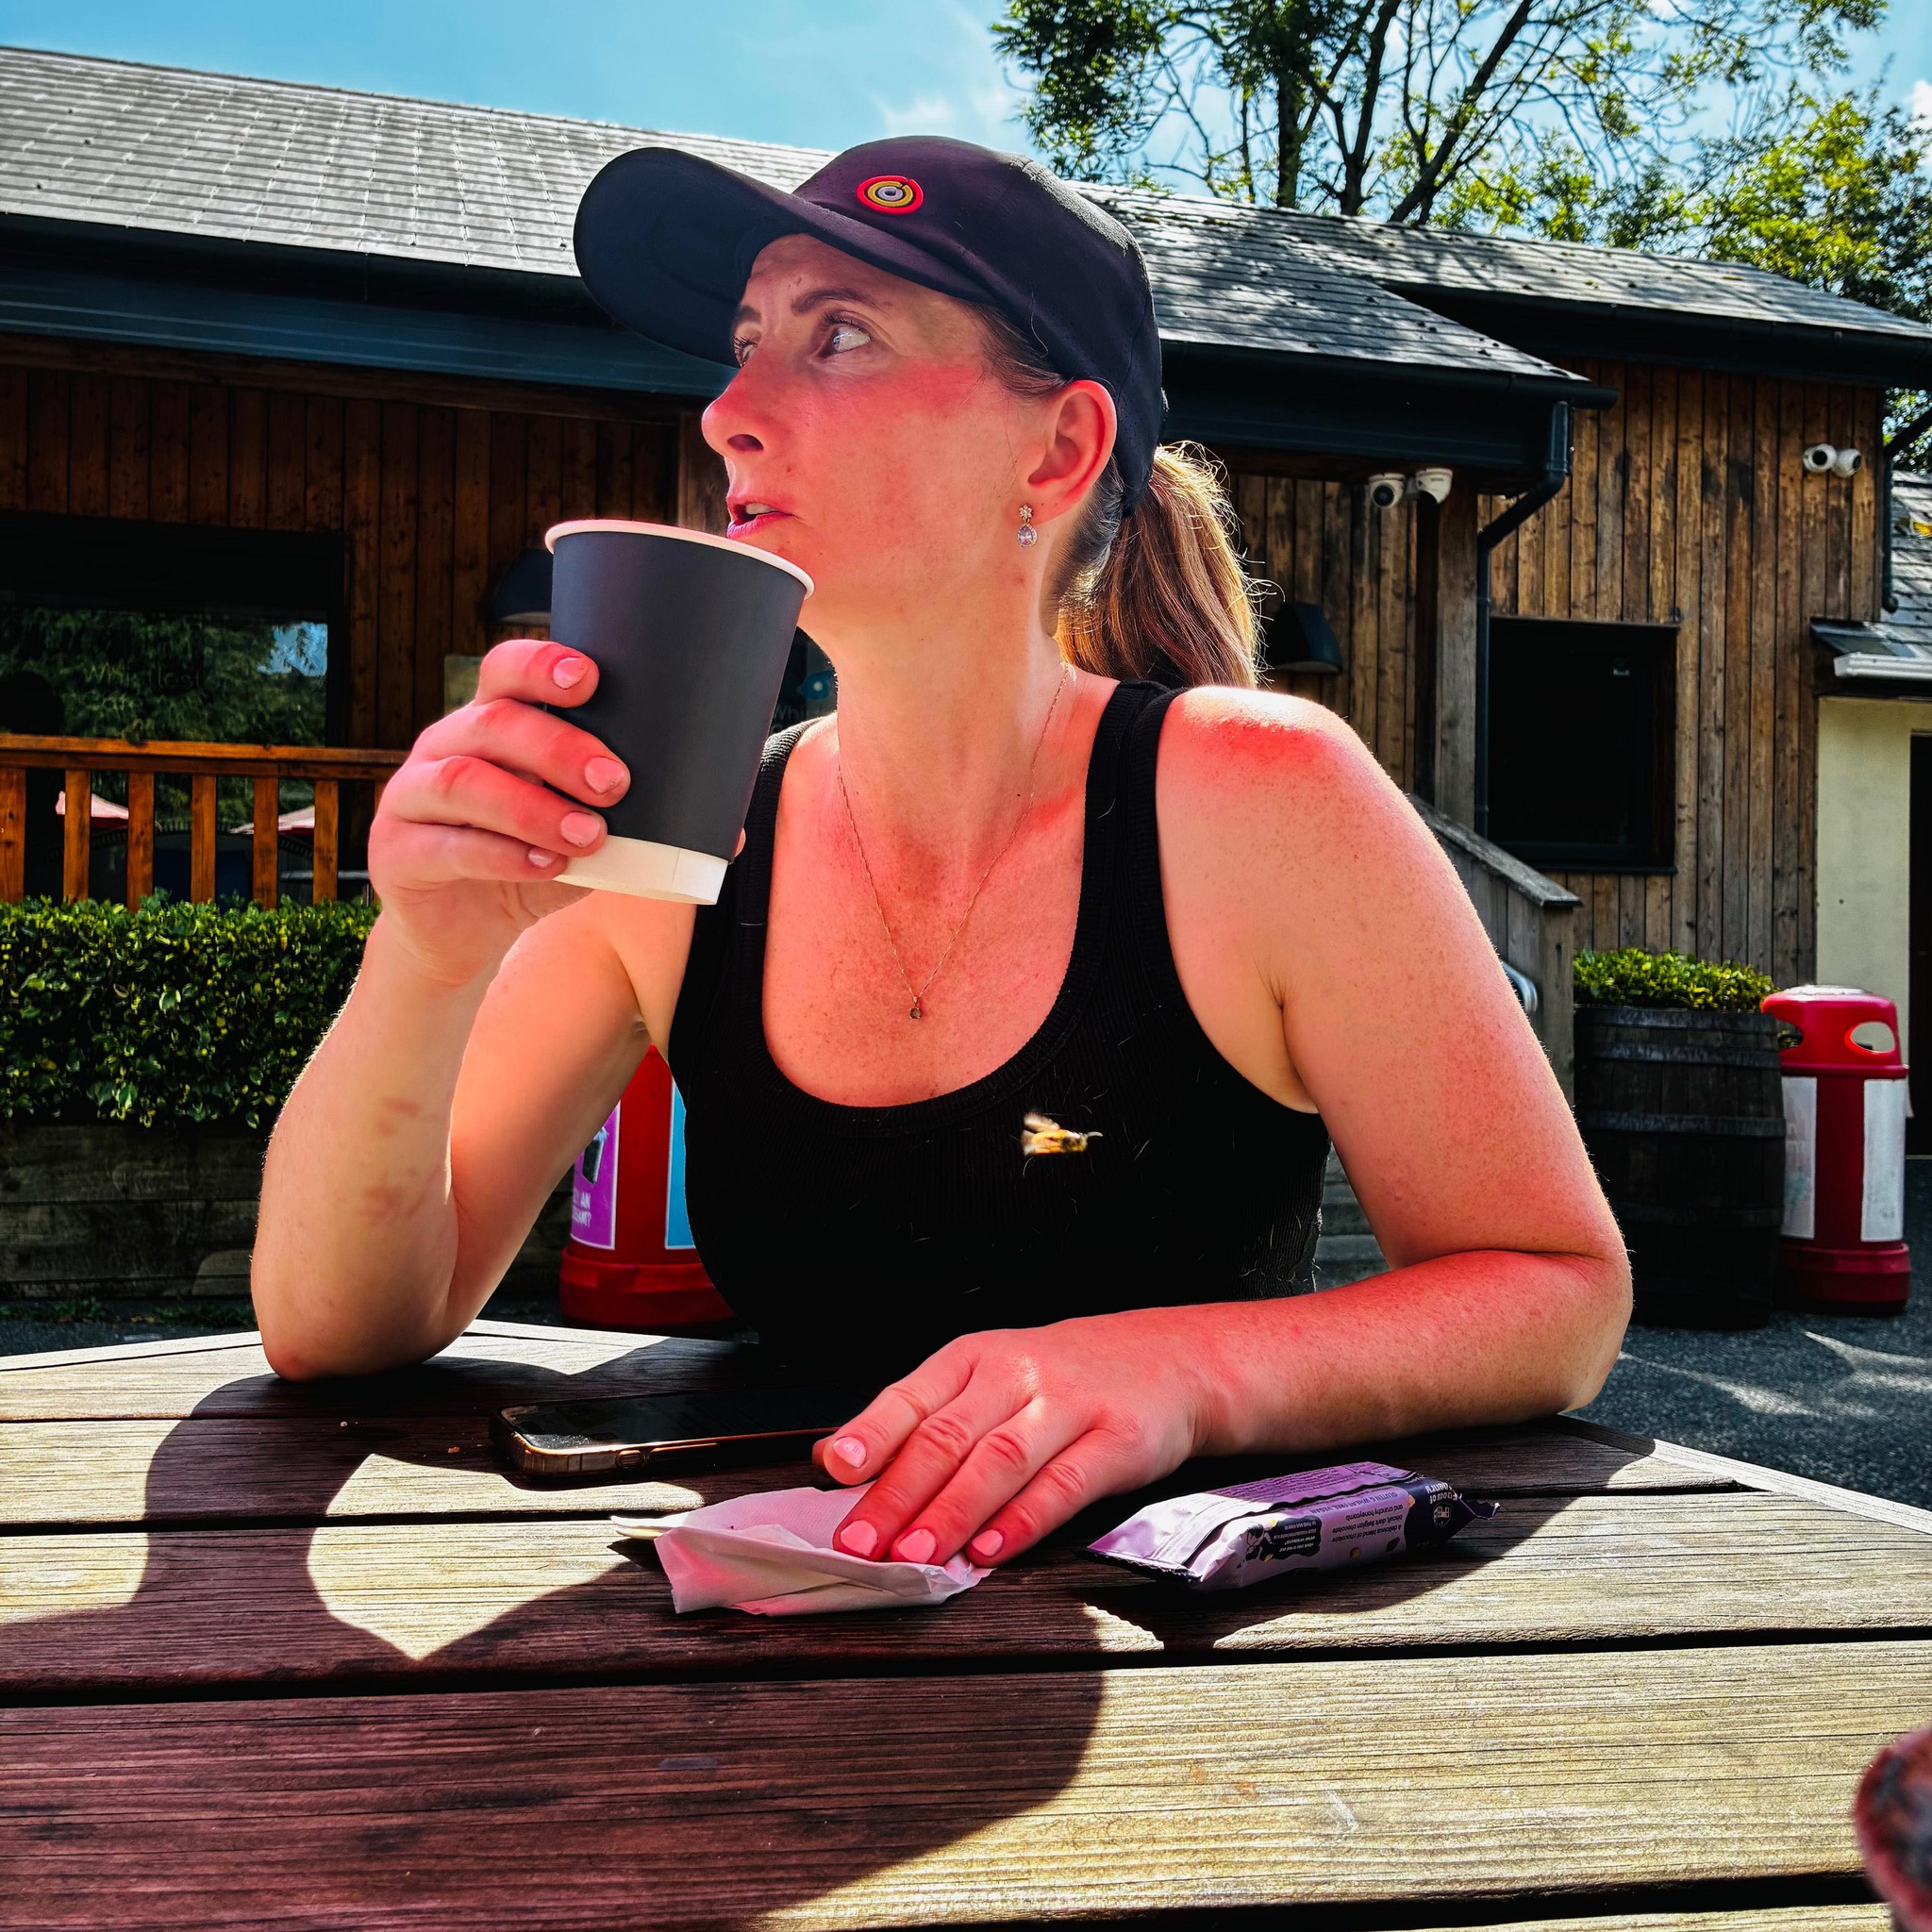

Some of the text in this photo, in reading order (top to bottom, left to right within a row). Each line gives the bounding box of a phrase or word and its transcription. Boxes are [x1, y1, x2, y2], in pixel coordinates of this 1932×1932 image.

[1429, 1494, 1437, 1505] of
[1345, 1504, 1404, 1521] and crunchy honeycomb
[1357, 1520, 1374, 1529] Belgian
[1374, 1518, 1386, 1526] dark
[1332, 1524, 1357, 1534] chocolate
[1377, 1525, 1397, 1534] delicious
[1332, 1533, 1357, 1542] chocolate
